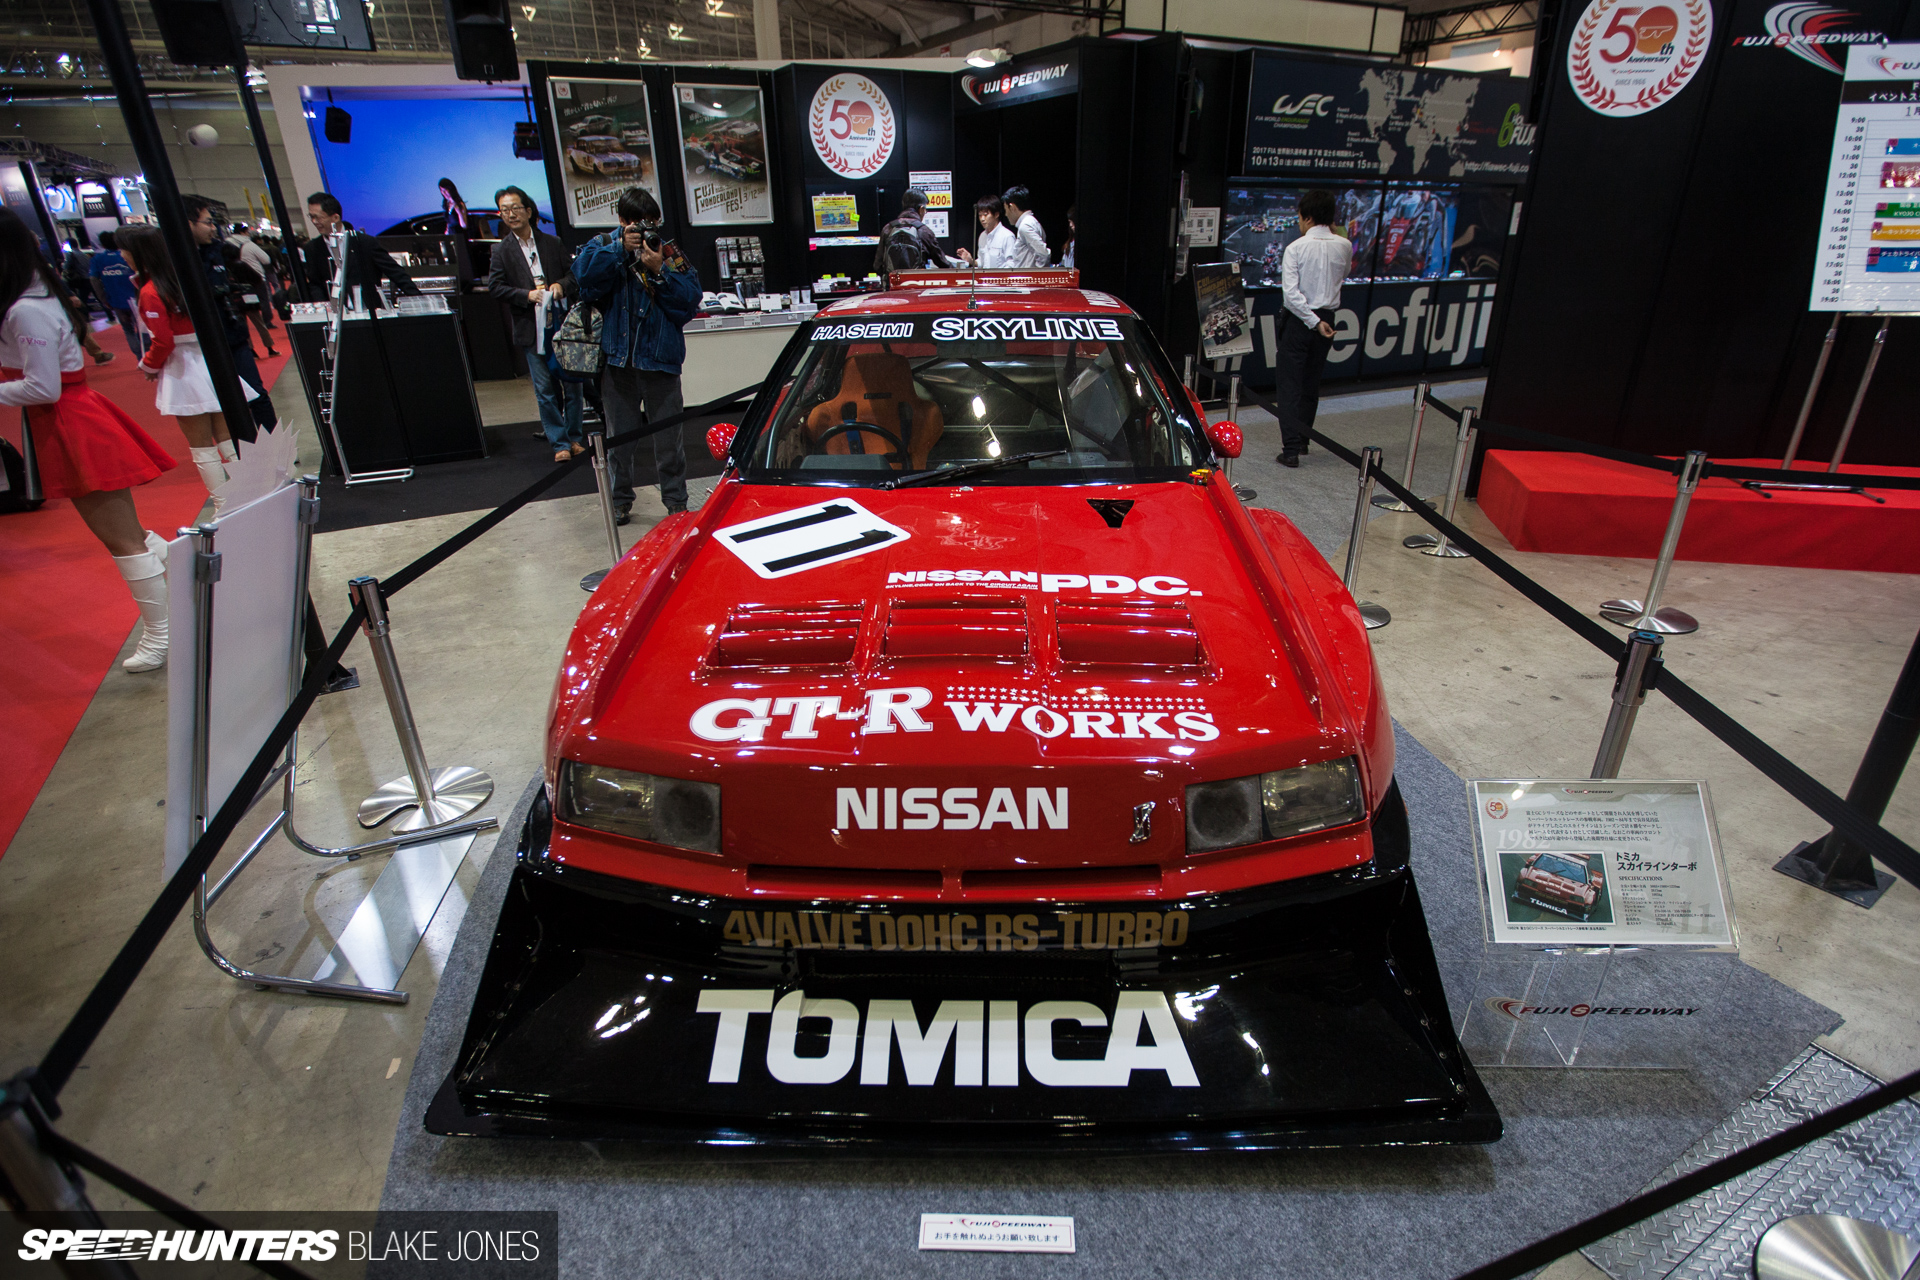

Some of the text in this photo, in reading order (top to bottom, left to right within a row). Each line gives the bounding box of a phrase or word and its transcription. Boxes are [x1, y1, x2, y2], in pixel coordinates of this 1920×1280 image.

[1627, 56, 1671, 64] Anniversary
[1272, 93, 1335, 117] WEC
[1869, 91, 1920, 102] イベントス
[574, 183, 597, 216] FUJI
[694, 183, 714, 214] FUJI
[811, 317, 1125, 341] HASEMI SKYLINE
[730, 503, 898, 573] 11
[887, 569, 1038, 583] NISSAN
[689, 687, 1221, 742] GT-R WORKS
[835, 787, 1068, 830] NISSAN
[1616, 852, 1640, 862] トミカ
[1617, 861, 1698, 872] スカイラインターボ
[723, 910, 1190, 952] 4VALVE DOHC RS-TURBO
[1519, 1004, 1701, 1017] FUJI SPEEDWAY
[696, 989, 1201, 1087] TOMICA
[934, 1232, 1060, 1243] お手を触れぬようお願い致します
